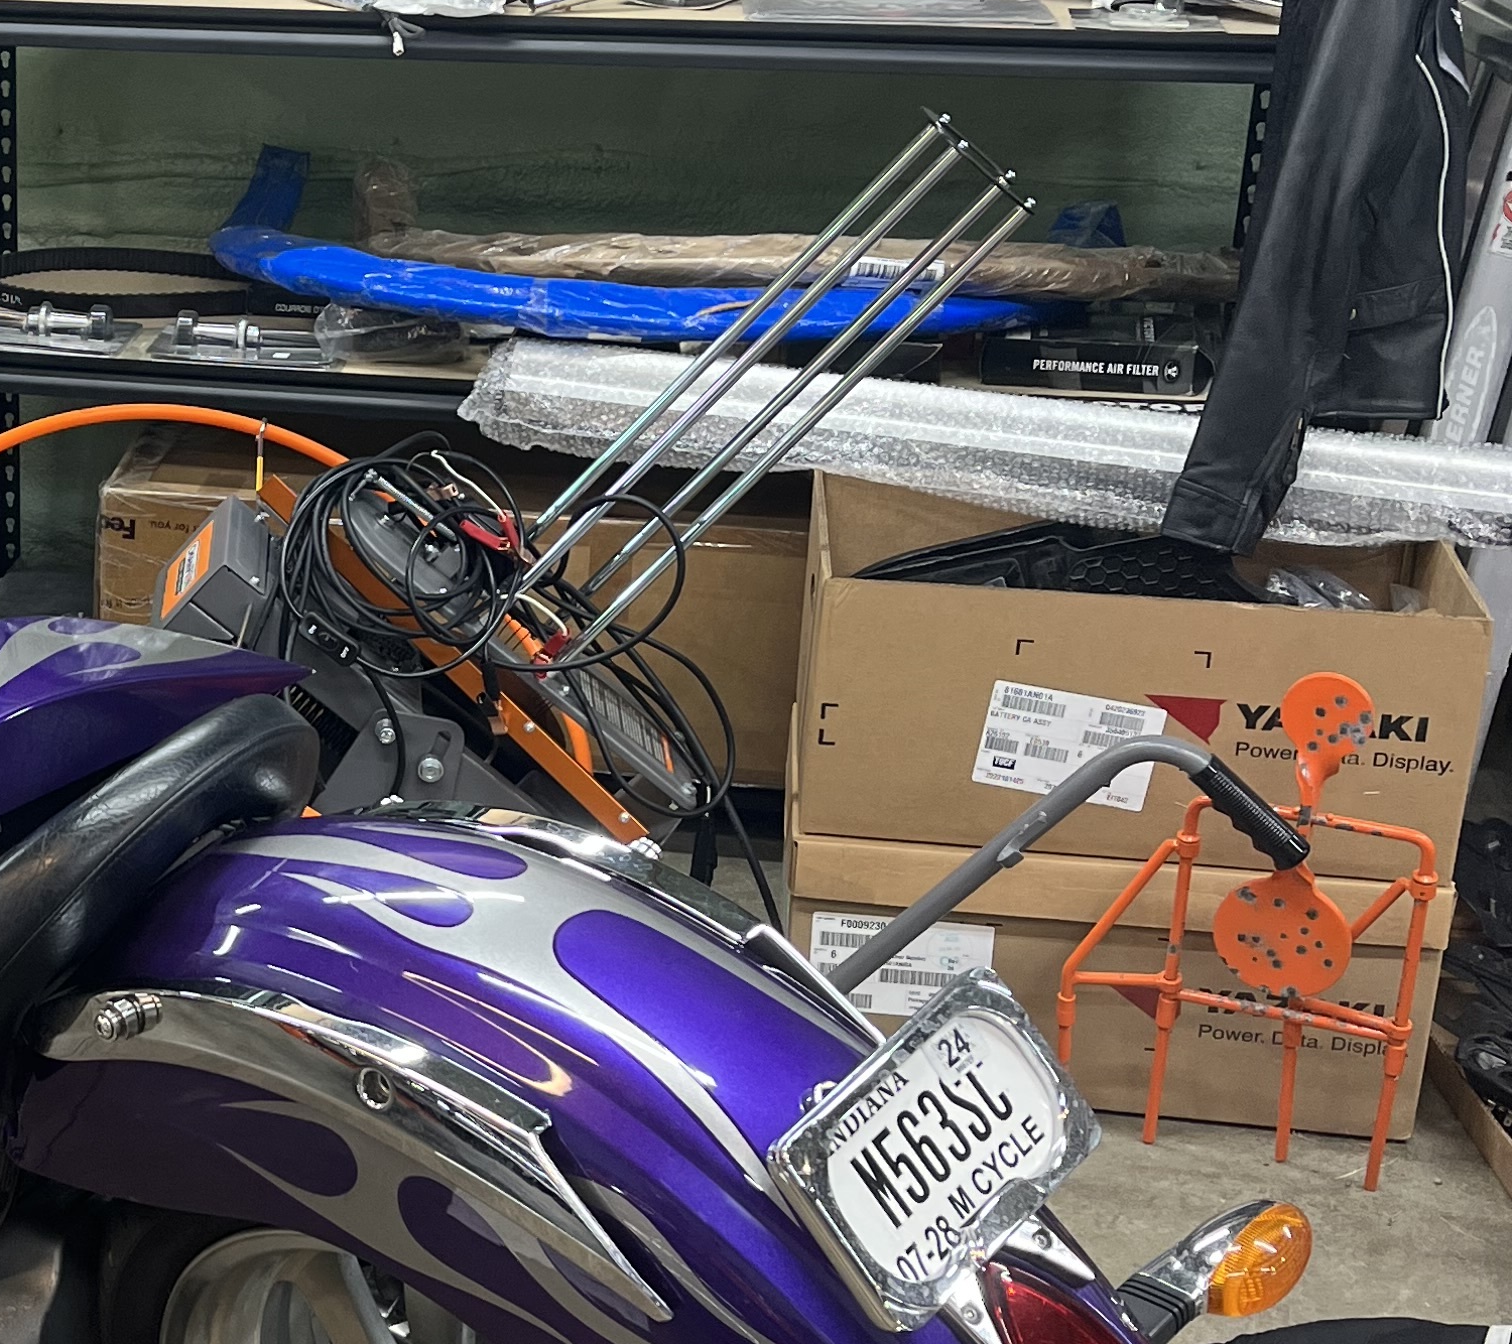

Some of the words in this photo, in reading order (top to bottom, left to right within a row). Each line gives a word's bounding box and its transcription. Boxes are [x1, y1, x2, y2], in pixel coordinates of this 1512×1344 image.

[1032, 359, 1105, 374] PERFORMANCE
[1106, 362, 1124, 375] AIR
[1126, 363, 1160, 376] FILTER
[1444, 344, 1487, 446] ERNER
[1237, 703, 1429, 743] YAKI
[1372, 752, 1455, 774] Display.
[830, 949, 837, 958] 6
[938, 1027, 971, 1068] 24
[1198, 1024, 1265, 1045] Power.
[1272, 1031, 1323, 1050] Dta.
[829, 1070, 909, 1155] NDIANA
[896, 1215, 962, 1281] 07-28
[947, 1185, 976, 1220] M
[971, 1115, 1045, 1195] CYCLE
